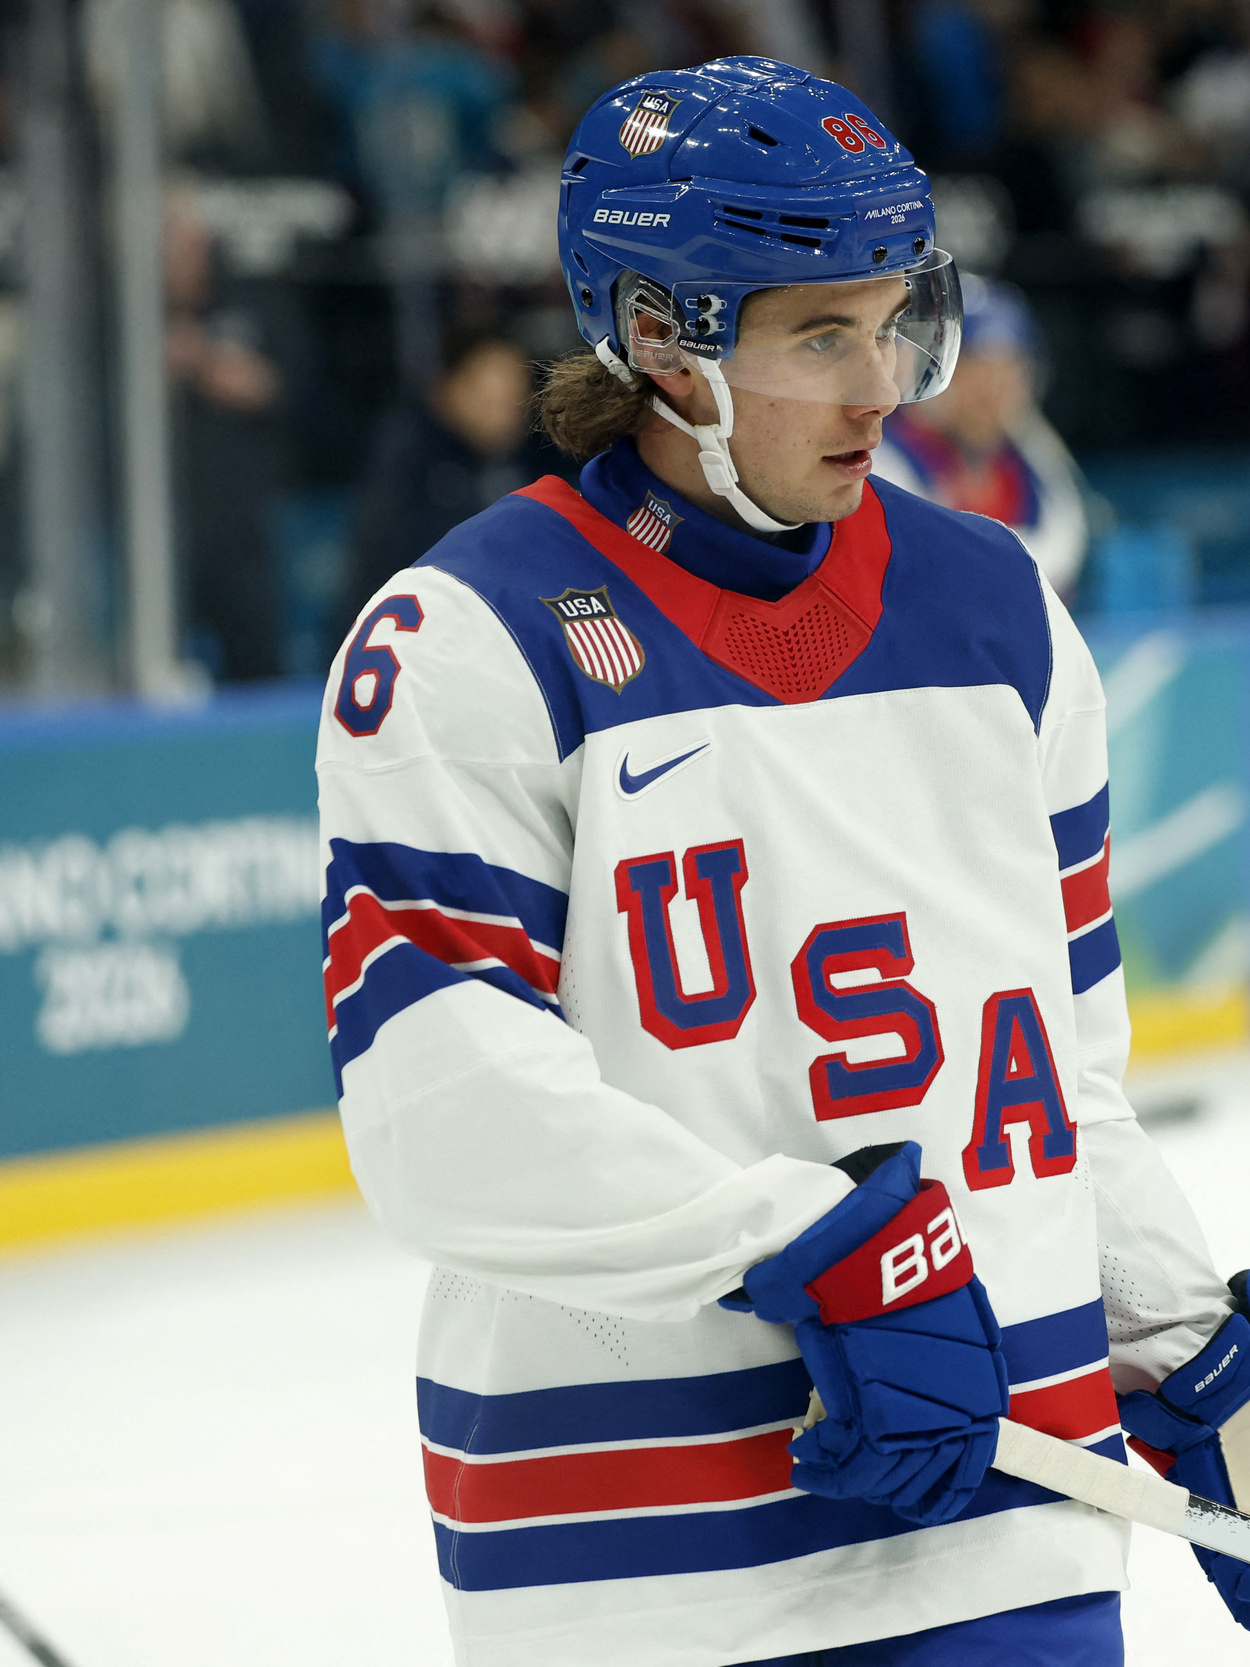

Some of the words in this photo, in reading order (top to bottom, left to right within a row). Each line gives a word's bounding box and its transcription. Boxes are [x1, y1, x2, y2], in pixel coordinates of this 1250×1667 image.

[643, 96, 669, 113] USA
[821, 113, 886, 154] 86
[864, 205, 896, 220] MILANO
[897, 200, 924, 213] CORTINA
[890, 214, 906, 224] 2026
[648, 500, 671, 525] USA
[558, 596, 606, 617] USA
[330, 594, 425, 738] 6
[614, 838, 1078, 1192] USA
